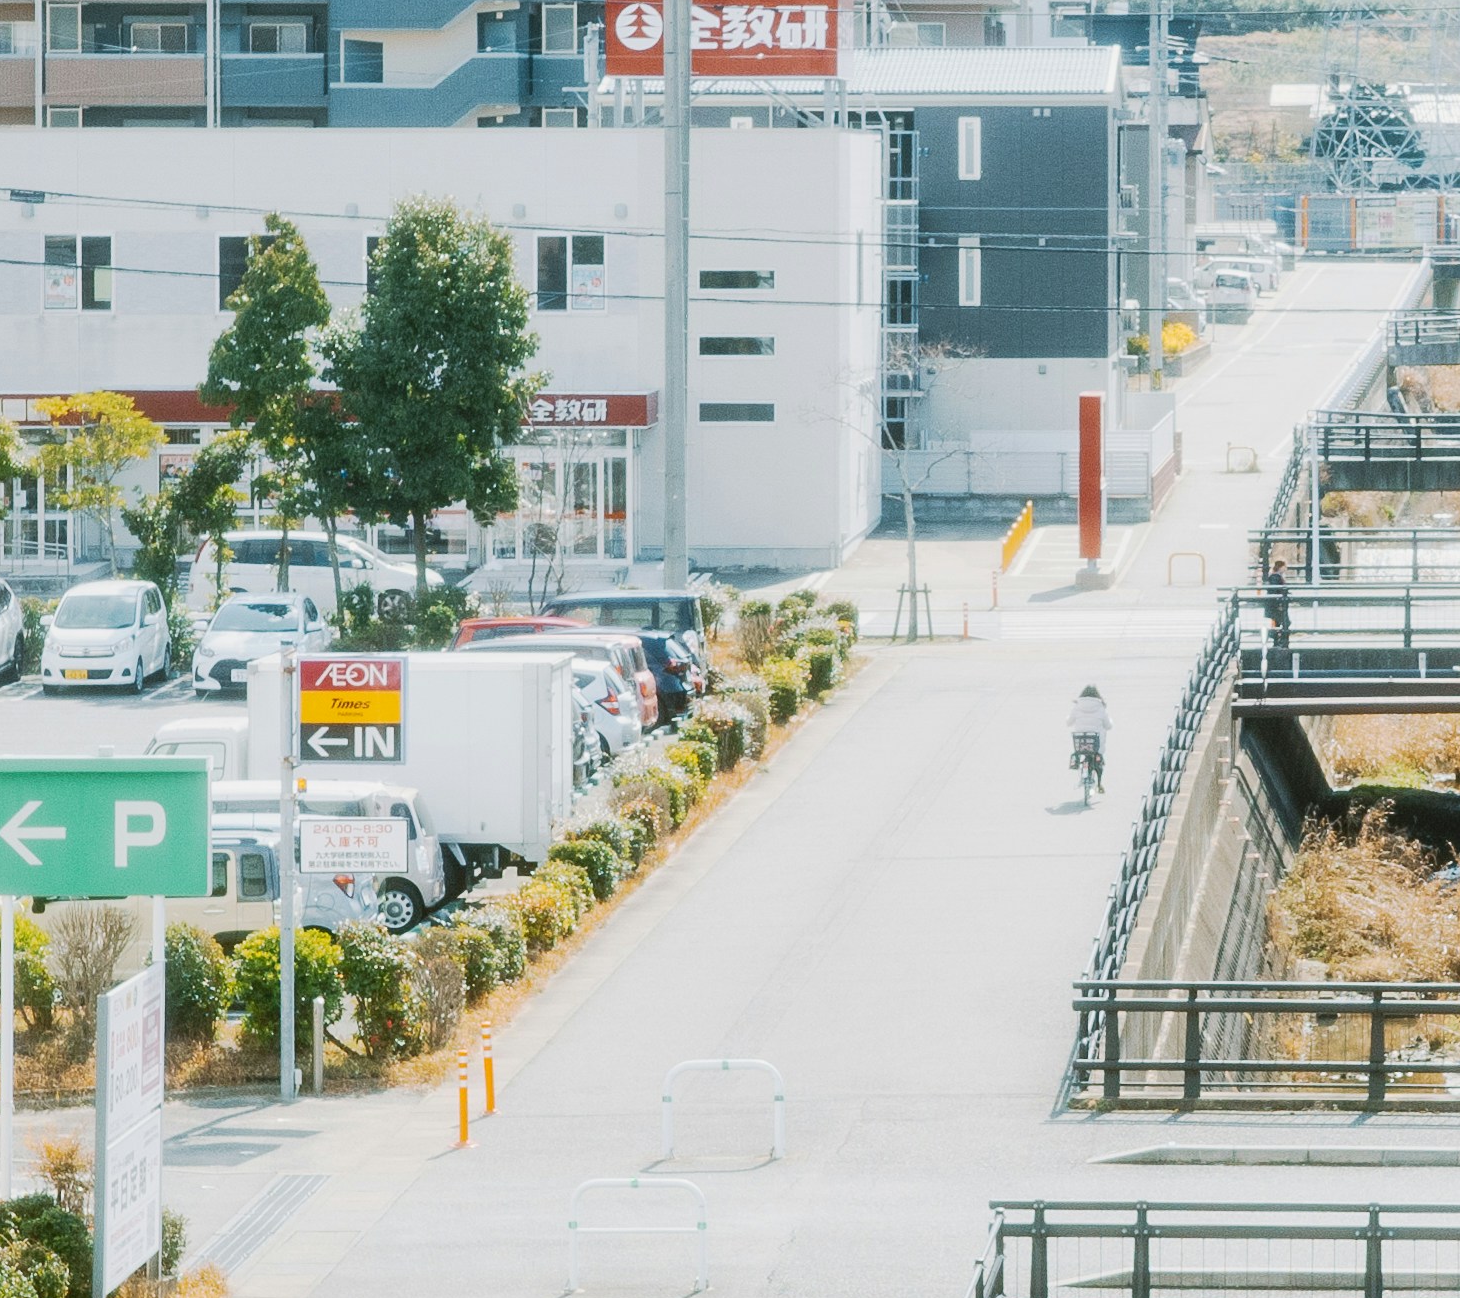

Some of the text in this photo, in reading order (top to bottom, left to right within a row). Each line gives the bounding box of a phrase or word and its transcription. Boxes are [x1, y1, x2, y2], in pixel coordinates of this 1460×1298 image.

[531, 399, 607, 422] 全教研
[330, 698, 370, 709] Times
[354, 727, 394, 757] IN
[115, 801, 166, 867] P
[325, 837, 379, 847] 入庫不可
